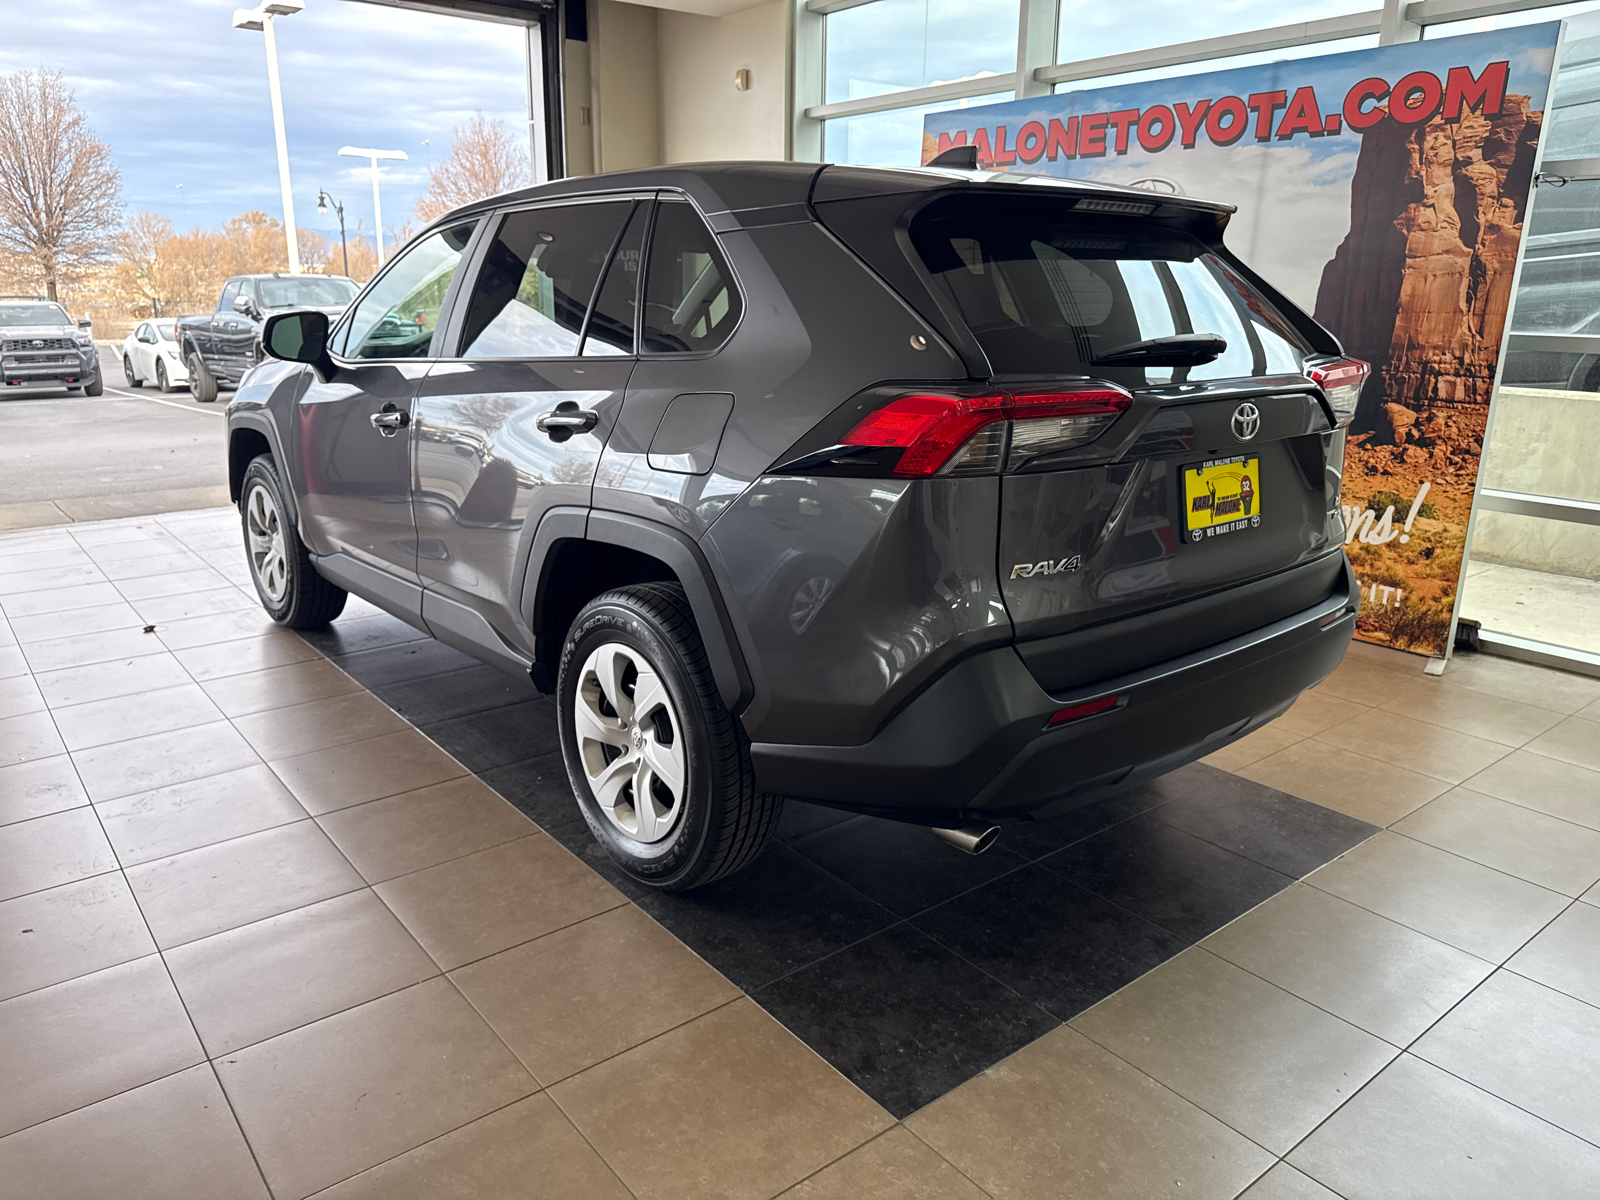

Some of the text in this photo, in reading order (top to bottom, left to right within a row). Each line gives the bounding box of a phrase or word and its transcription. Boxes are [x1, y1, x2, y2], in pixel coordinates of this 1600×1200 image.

[938, 60, 1509, 169] MALONETOYOTA.COM
[1203, 456, 1244, 468] KARL MALONE TOYOTA
[1242, 481, 1250, 491] 32
[1191, 495, 1211, 513] KARL
[1214, 498, 1241, 517] MALONE
[1206, 519, 1248, 537] WE MAKE IT EASY
[1010, 554, 1081, 579] RAV4
[1369, 583, 1402, 607] IT!
